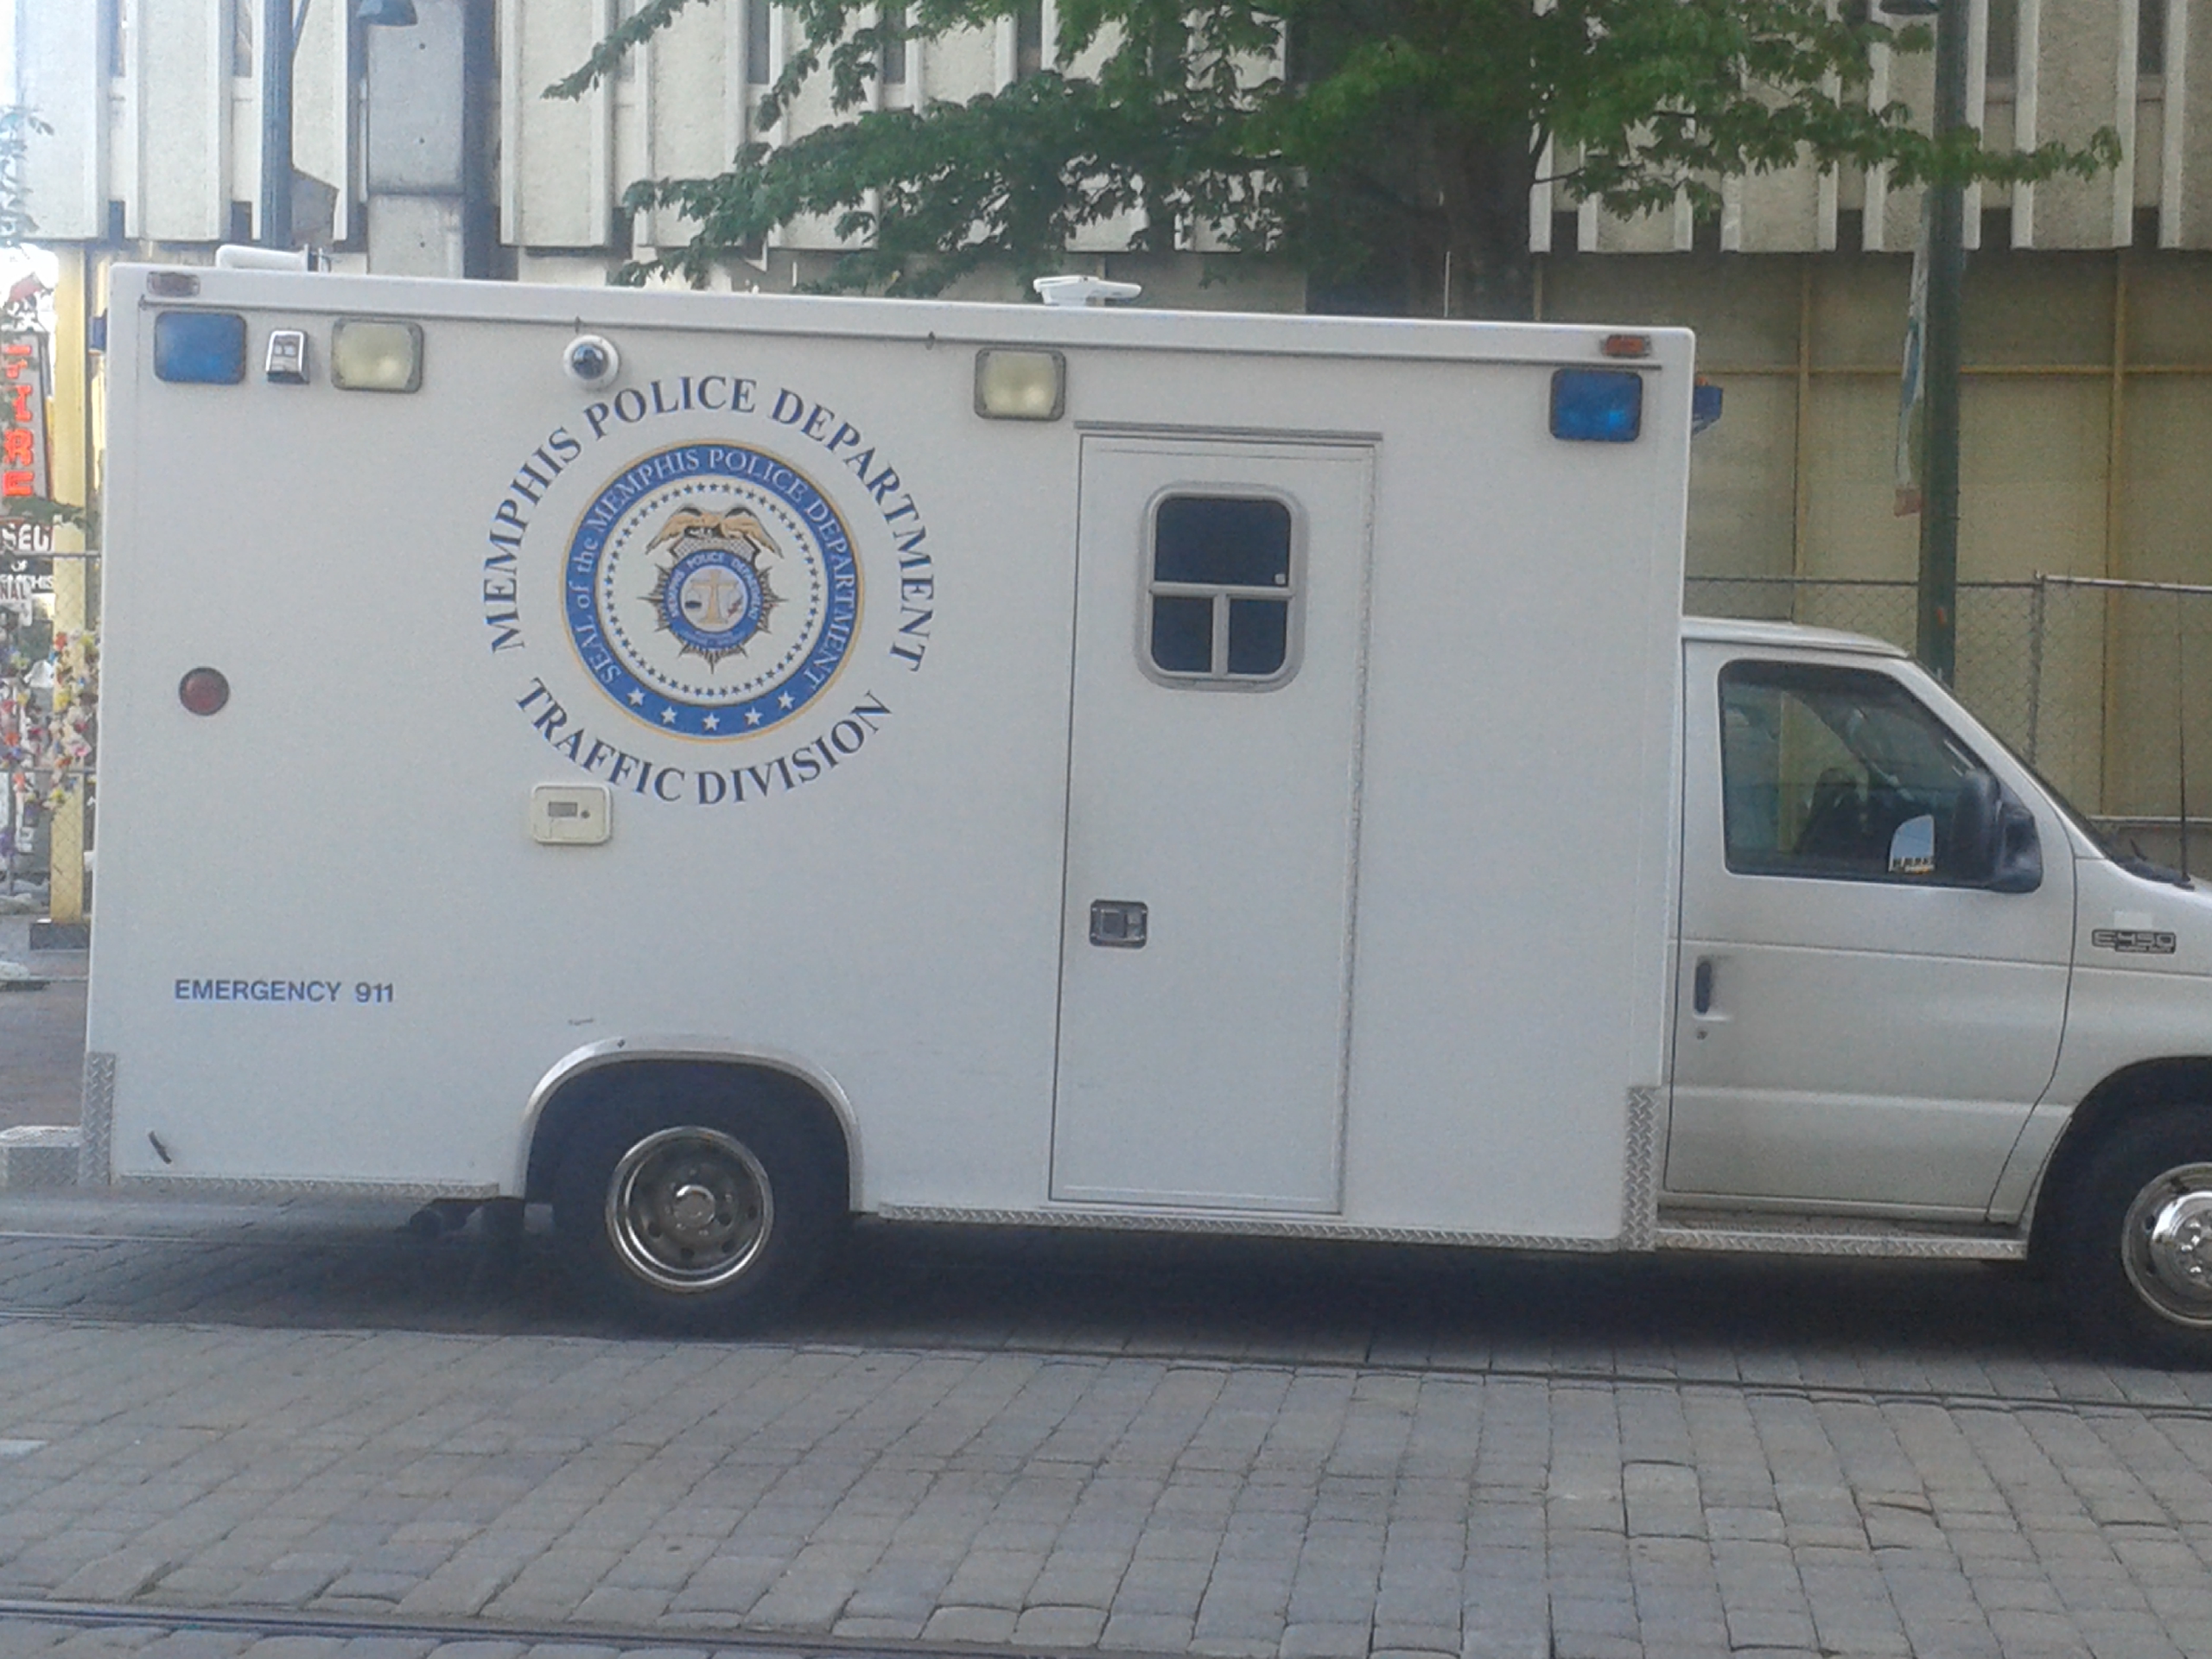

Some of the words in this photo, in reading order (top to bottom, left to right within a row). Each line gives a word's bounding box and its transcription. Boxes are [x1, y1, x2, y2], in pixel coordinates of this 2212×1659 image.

[587, 449, 699, 533] MEMPHIS
[709, 449, 809, 503] POLICE
[2, 524, 54, 551] SEU
[484, 426, 582, 654] MEMPHIS
[583, 375, 757, 441] POLICE
[767, 388, 935, 672] DEPARTMENT
[574, 537, 599, 574] the
[686, 552, 725, 569] POLICE
[569, 580, 592, 608] of
[804, 499, 855, 690] DEPARTMENT
[575, 615, 621, 683] SEAL
[516, 677, 685, 802] TRAFFIC
[697, 690, 893, 804] DIVISION
[175, 978, 342, 1002] EMERGENCY
[354, 981, 394, 1003] 911
